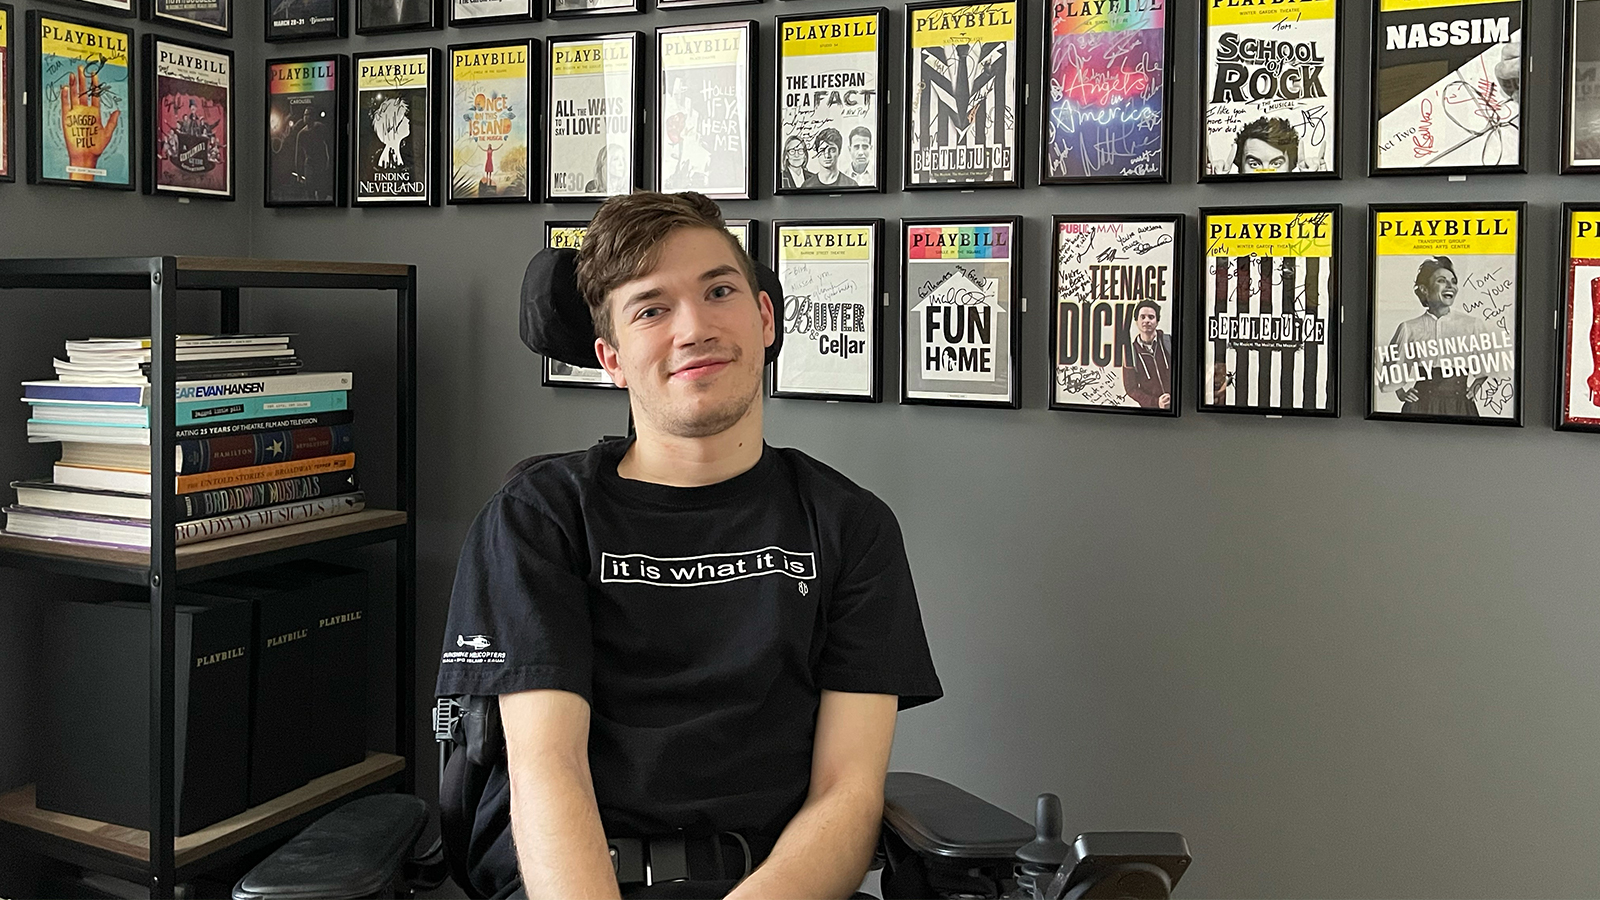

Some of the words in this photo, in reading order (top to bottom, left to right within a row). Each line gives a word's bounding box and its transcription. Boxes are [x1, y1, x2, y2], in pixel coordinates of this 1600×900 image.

[916, 10, 1012, 32] PLAYBILL
[42, 25, 126, 52] PLAYBILL
[784, 22, 876, 41] PLAYBILL
[1386, 17, 1510, 50] NASSIM
[556, 46, 628, 64] PLAYBILL
[665, 37, 740, 56] PLAYBILL
[1216, 32, 1325, 64] SCHOOL
[160, 50, 226, 74] PLAYBILL
[456, 51, 525, 68] PLAYBILL
[1265, 57, 1284, 77] of
[271, 66, 334, 81] PLAYBILL
[362, 63, 426, 78] PLAYBILL
[786, 75, 808, 90] THE
[810, 72, 865, 88] LIFESPAN
[1065, 68, 1146, 106] Angels
[1210, 62, 1328, 104] ROCK
[474, 93, 508, 112] ONCE
[556, 100, 576, 118] ALL
[577, 108, 587, 116] THE
[588, 97, 624, 116] WAYS
[707, 99, 723, 118] IF
[786, 94, 800, 107] OF
[803, 92, 810, 106] A
[814, 90, 876, 110] FACT
[1269, 101, 1295, 111] MUSICAL
[67, 114, 96, 127] JAGGED
[475, 112, 484, 120] ON
[485, 112, 497, 120] THIS
[72, 126, 98, 137] LITTLE
[469, 118, 512, 136] ISLAND
[554, 128, 565, 136] SAY
[566, 119, 570, 136] I
[572, 117, 600, 136] LOVE
[604, 116, 628, 134] YOU
[701, 120, 738, 136] HEAR
[76, 136, 96, 148] PILL
[714, 135, 740, 152] ME
[1379, 140, 1394, 154] Act
[1392, 126, 1417, 144] Two
[374, 172, 410, 182] FINDING
[554, 172, 567, 188] MCC
[568, 172, 584, 192] 30
[359, 180, 424, 196] NEVERLAND
[1059, 224, 1090, 234] PUBLIC
[1210, 224, 1326, 239] PLAYBILL
[1378, 218, 1508, 237] PLAYBILL
[556, 235, 584, 248] PLA
[783, 233, 868, 248] PLAYBILL
[912, 232, 1006, 247] PLAYBILL
[1089, 264, 1168, 302] TEENAGE
[926, 306, 991, 344] FUN
[1058, 302, 1136, 368] DICK
[819, 333, 866, 359] Cellar
[1376, 344, 1400, 363] HE
[1404, 330, 1513, 360] UNSINKABLE
[926, 346, 991, 373] HOME
[1375, 360, 1434, 386] MOLLY
[1440, 350, 1514, 378] BROWN
[196, 385, 224, 398] EVAN
[224, 382, 264, 395] HANSEN
[176, 429, 199, 437] RATING
[209, 426, 230, 434] YEARS
[290, 418, 318, 426] TELEVISION
[214, 448, 252, 458] HAMILTON
[200, 476, 234, 486] UNTOLD
[236, 472, 265, 481] STORIES
[274, 465, 312, 476] BROADWAY
[204, 484, 264, 514] BROADWAY
[268, 476, 320, 504] MUSICALS
[176, 514, 251, 540] ROADWAY
[258, 502, 324, 524] MUSICALS
[612, 560, 630, 576] it
[640, 560, 661, 580] is
[670, 558, 746, 580] what
[756, 552, 774, 570] it
[784, 556, 805, 574] is
[319, 611, 362, 628] PLAYBILL
[266, 629, 308, 648] PLAYBILL
[196, 647, 244, 668] PLAYBILL
